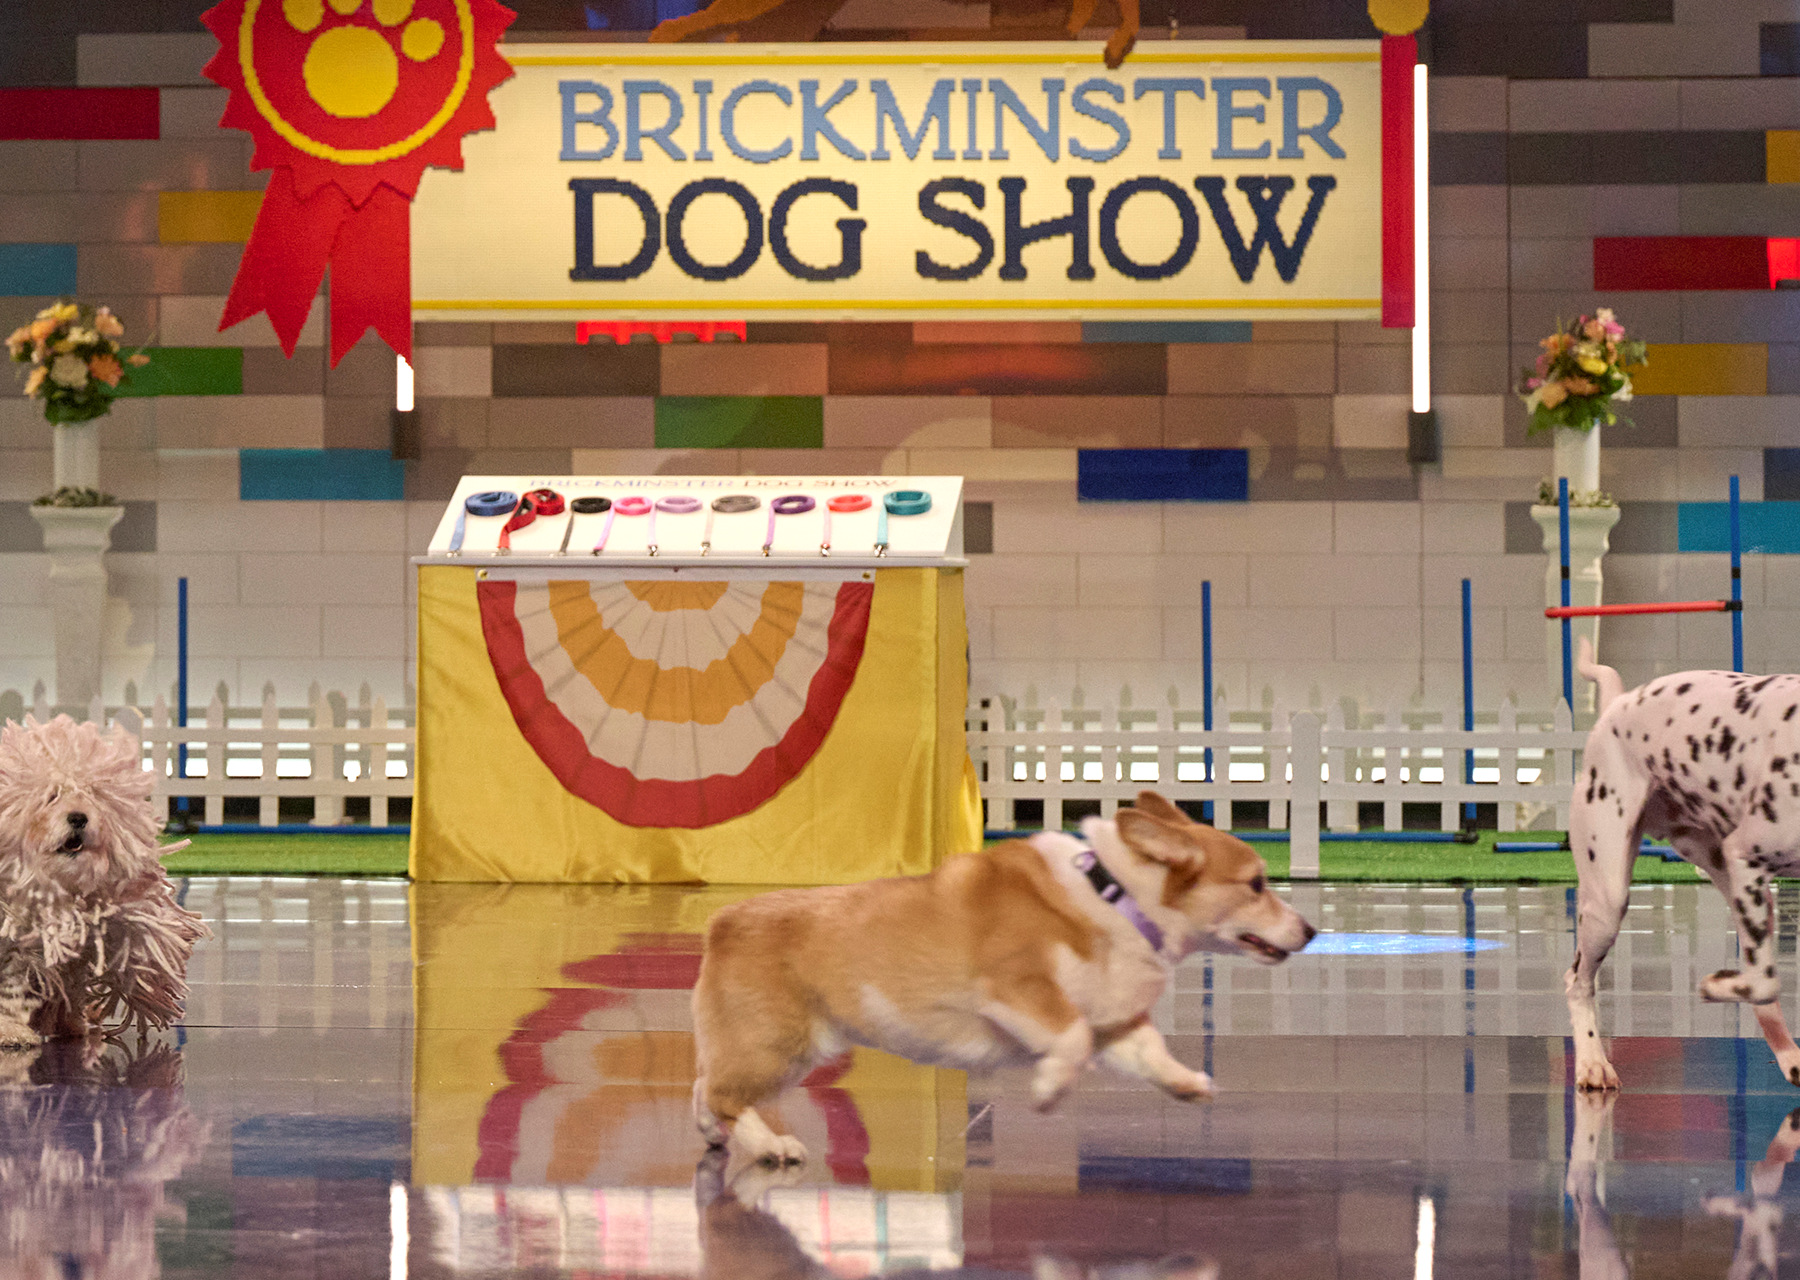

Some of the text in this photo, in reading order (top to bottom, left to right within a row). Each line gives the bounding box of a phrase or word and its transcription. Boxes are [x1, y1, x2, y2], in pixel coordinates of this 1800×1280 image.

[558, 76, 1347, 164] BRICKMINSTER
[568, 175, 1337, 285] DOG SHOW
[530, 479, 898, 488] BRICKMINSTER DOG SHOW
